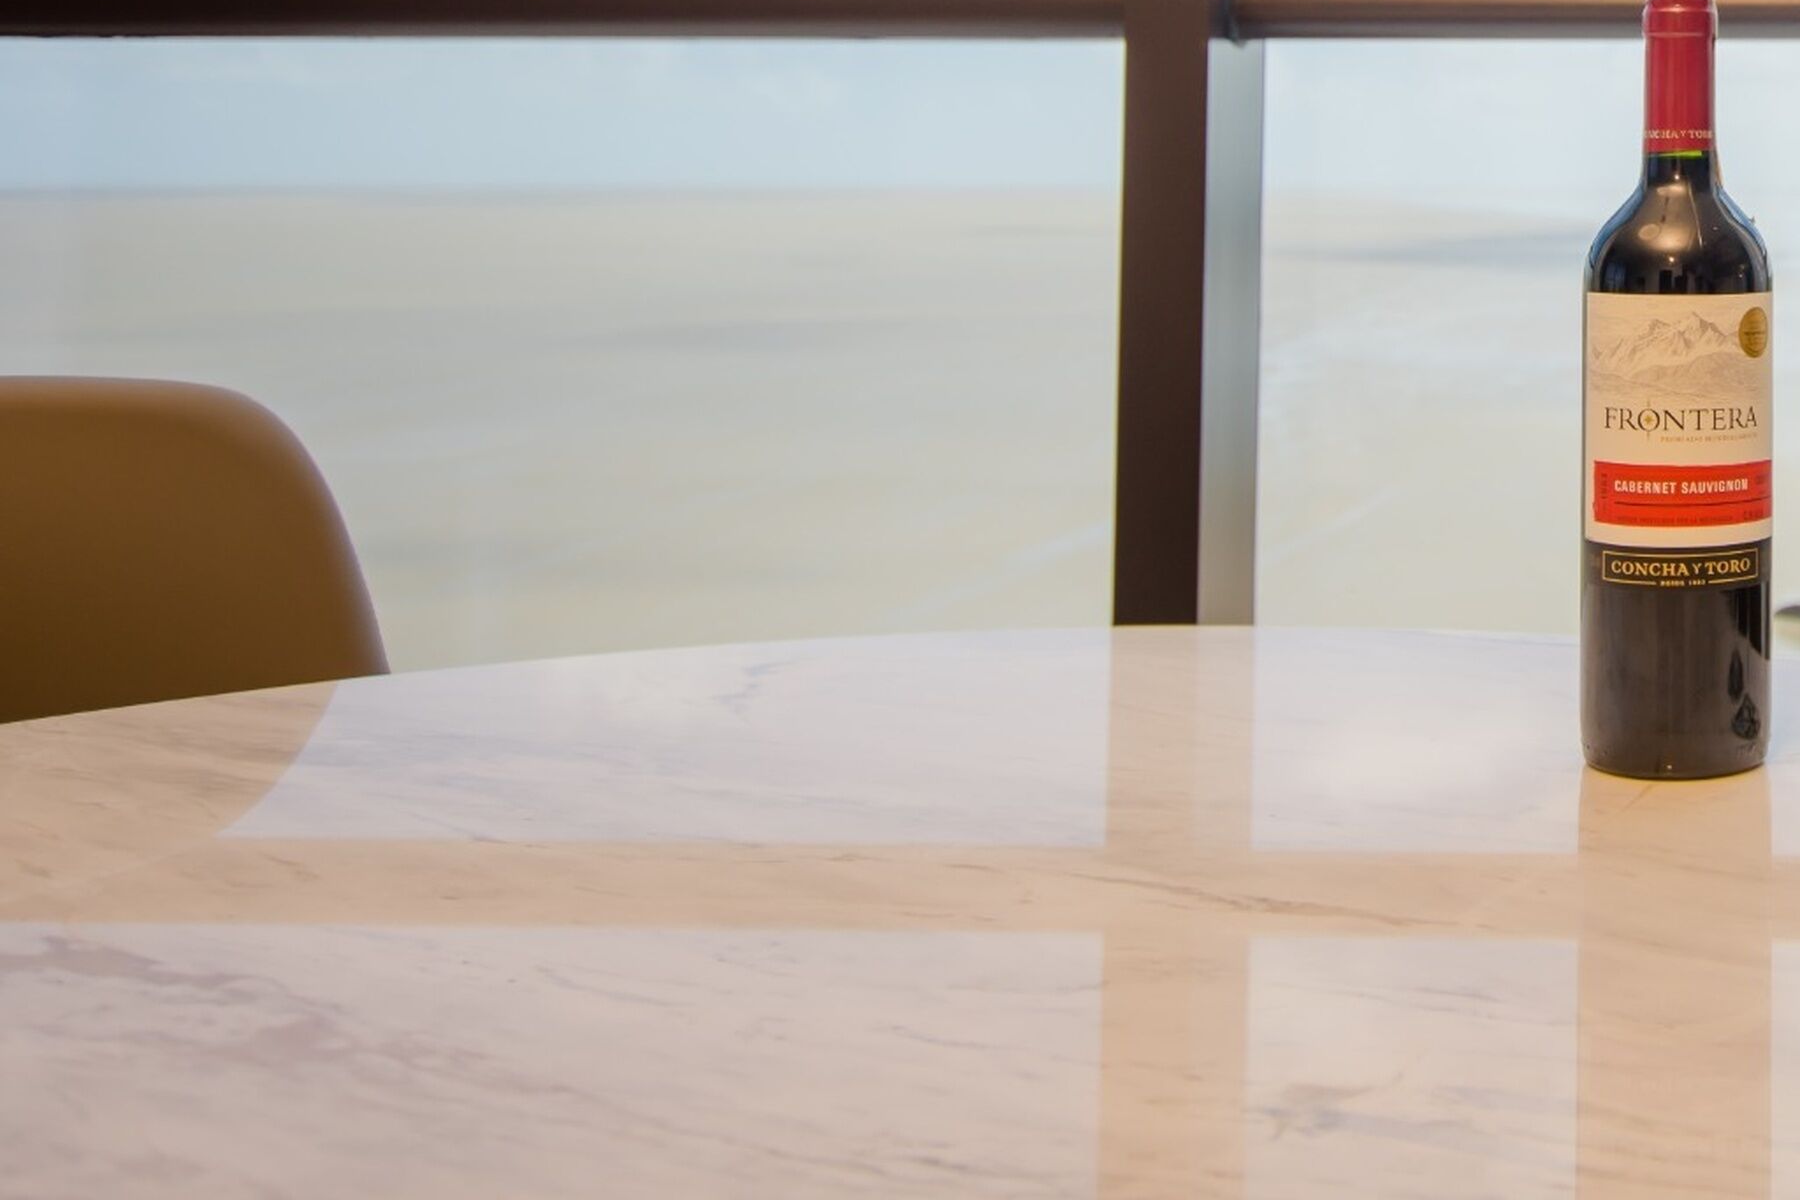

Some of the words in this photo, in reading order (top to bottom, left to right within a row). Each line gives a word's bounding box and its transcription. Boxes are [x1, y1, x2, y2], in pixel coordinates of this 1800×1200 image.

[1604, 406, 1758, 432] FRONTERA
[1614, 479, 1677, 495] CABERNET
[1681, 478, 1749, 495] SAUVIGNON
[1611, 559, 1690, 577] CONCHA
[1692, 563, 1702, 575] Y
[1704, 557, 1751, 576] TORO
